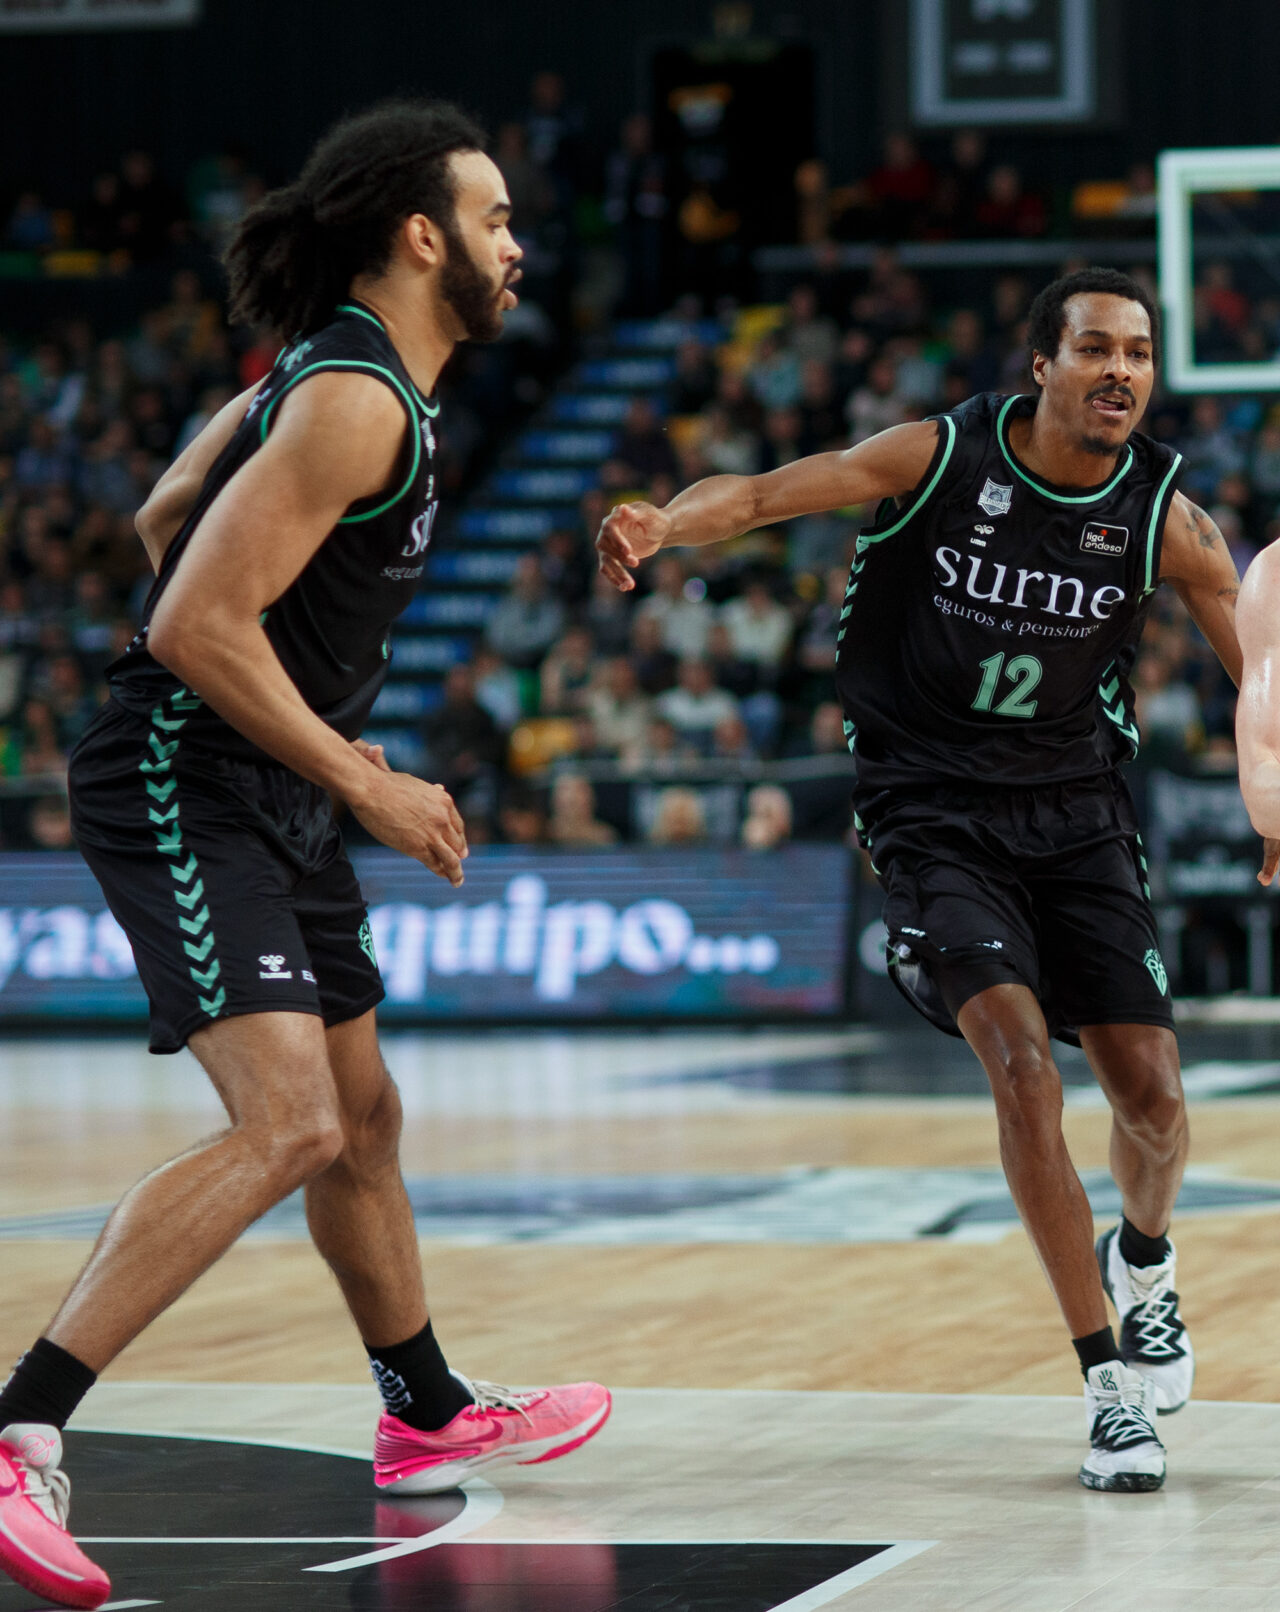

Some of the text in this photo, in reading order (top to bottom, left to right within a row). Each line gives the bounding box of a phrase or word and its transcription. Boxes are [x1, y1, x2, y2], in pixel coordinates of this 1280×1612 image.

[1084, 541, 1122, 553] endesa
[1086, 531, 1105, 543] liga
[935, 546, 1126, 619] surne
[933, 593, 996, 617] eguros
[1002, 618, 1014, 632] &
[970, 651, 1043, 718] 12
[366, 872, 780, 1001] quipo...
